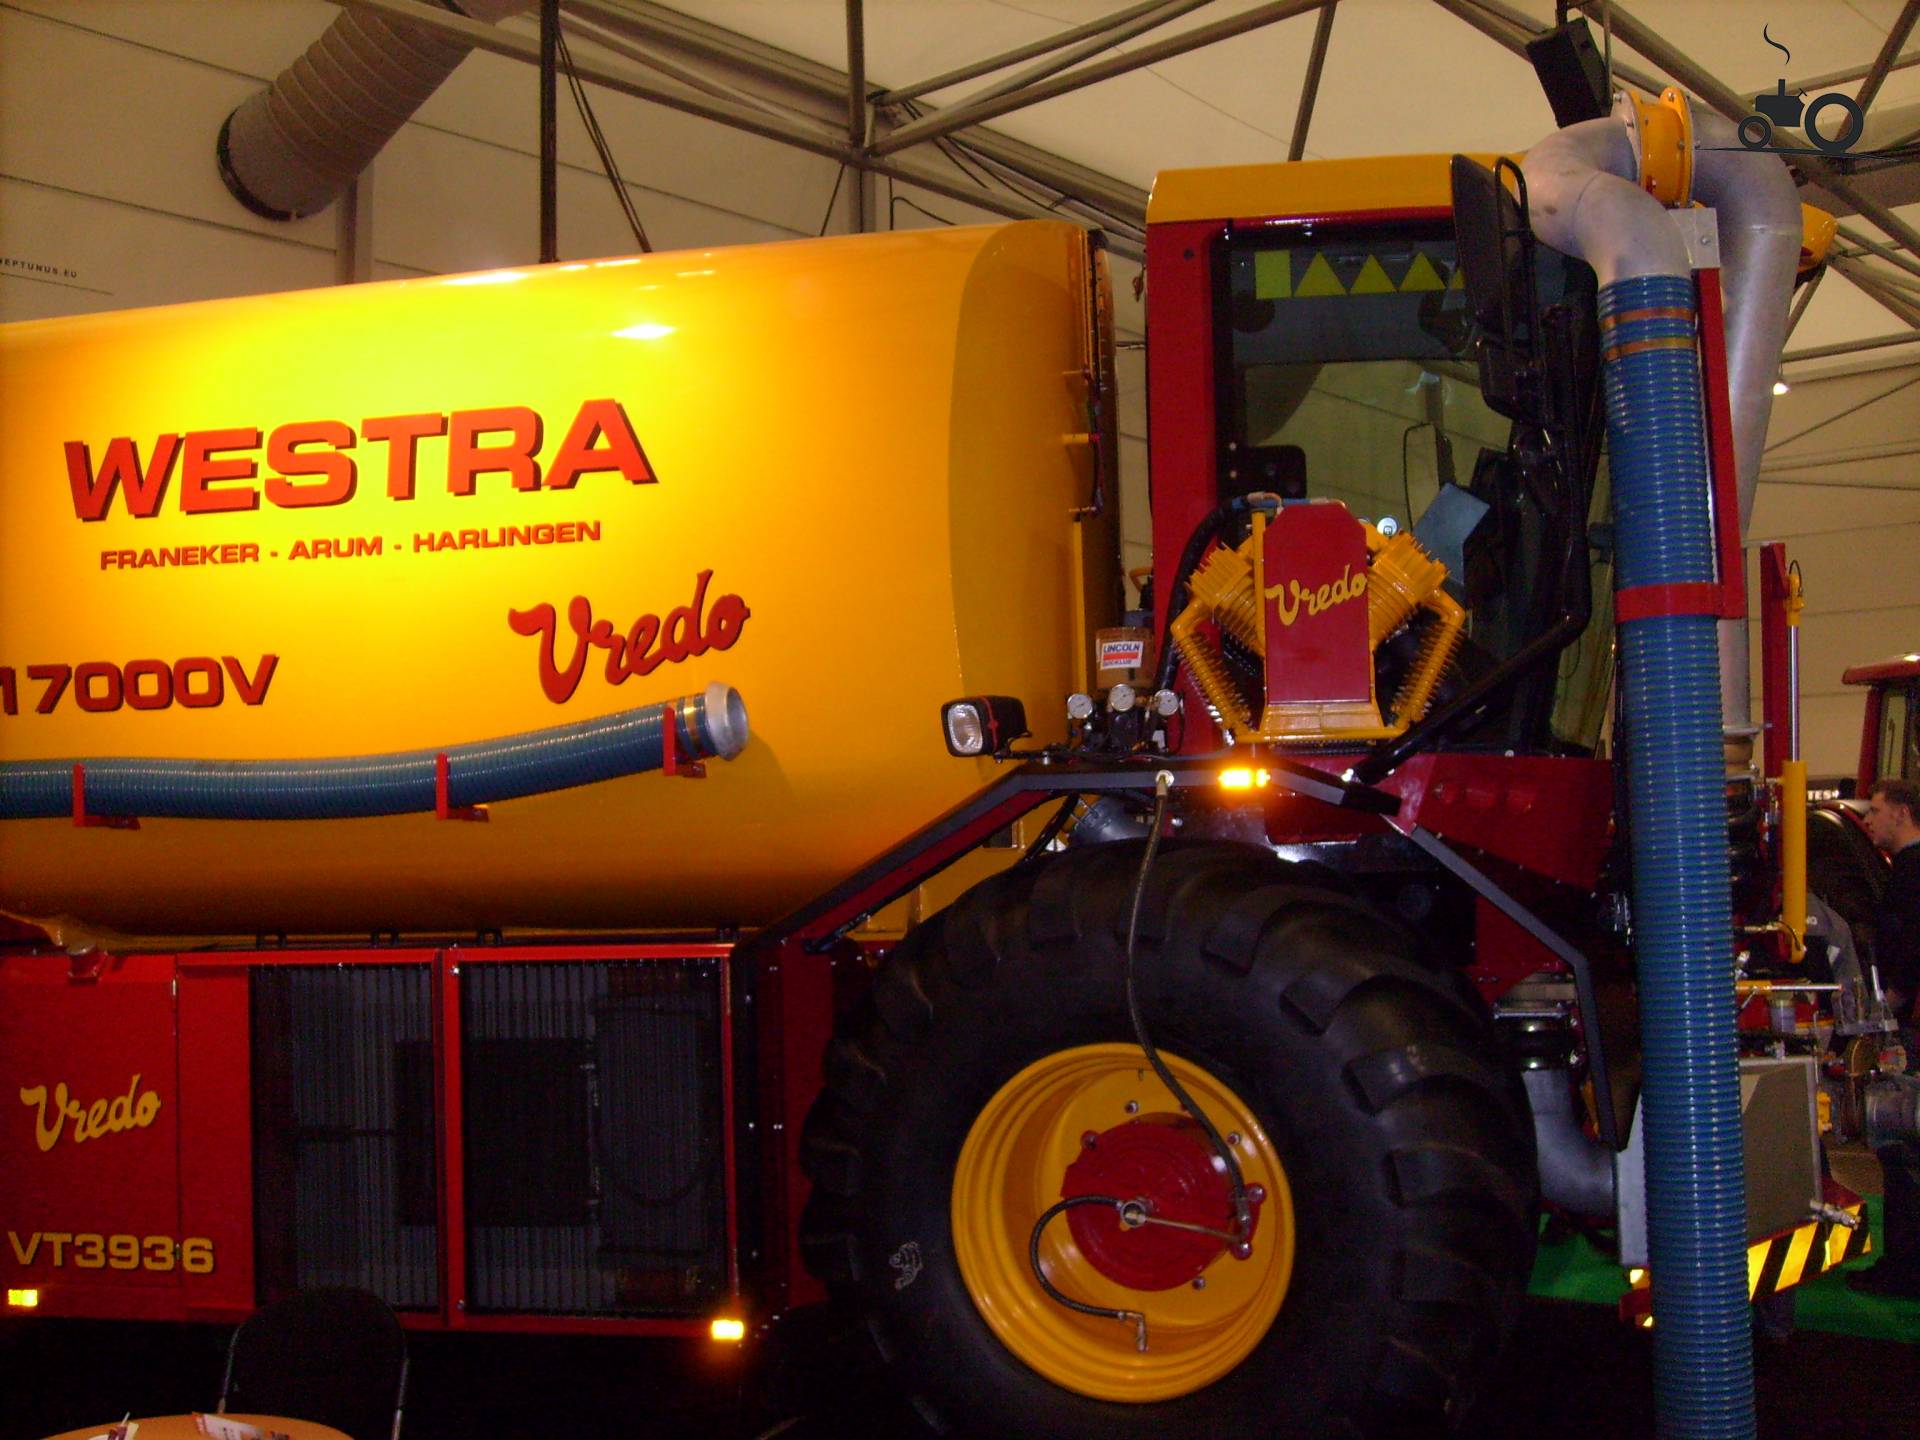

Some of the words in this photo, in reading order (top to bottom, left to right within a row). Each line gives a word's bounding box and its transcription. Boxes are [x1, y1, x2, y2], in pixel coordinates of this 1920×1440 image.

[64, 398, 659, 522] WESTRA
[100, 544, 260, 570] FRANEKER
[288, 536, 383, 560] ARUM
[412, 520, 601, 554] HARLINGEN
[1264, 564, 1368, 626] Vredo
[508, 568, 751, 705] Vredo
[1103, 643, 1140, 653] LINCOLN
[0, 654, 279, 716] 17000V
[20, 1073, 161, 1152] Vredo
[8, 1231, 215, 1274] VT3936
